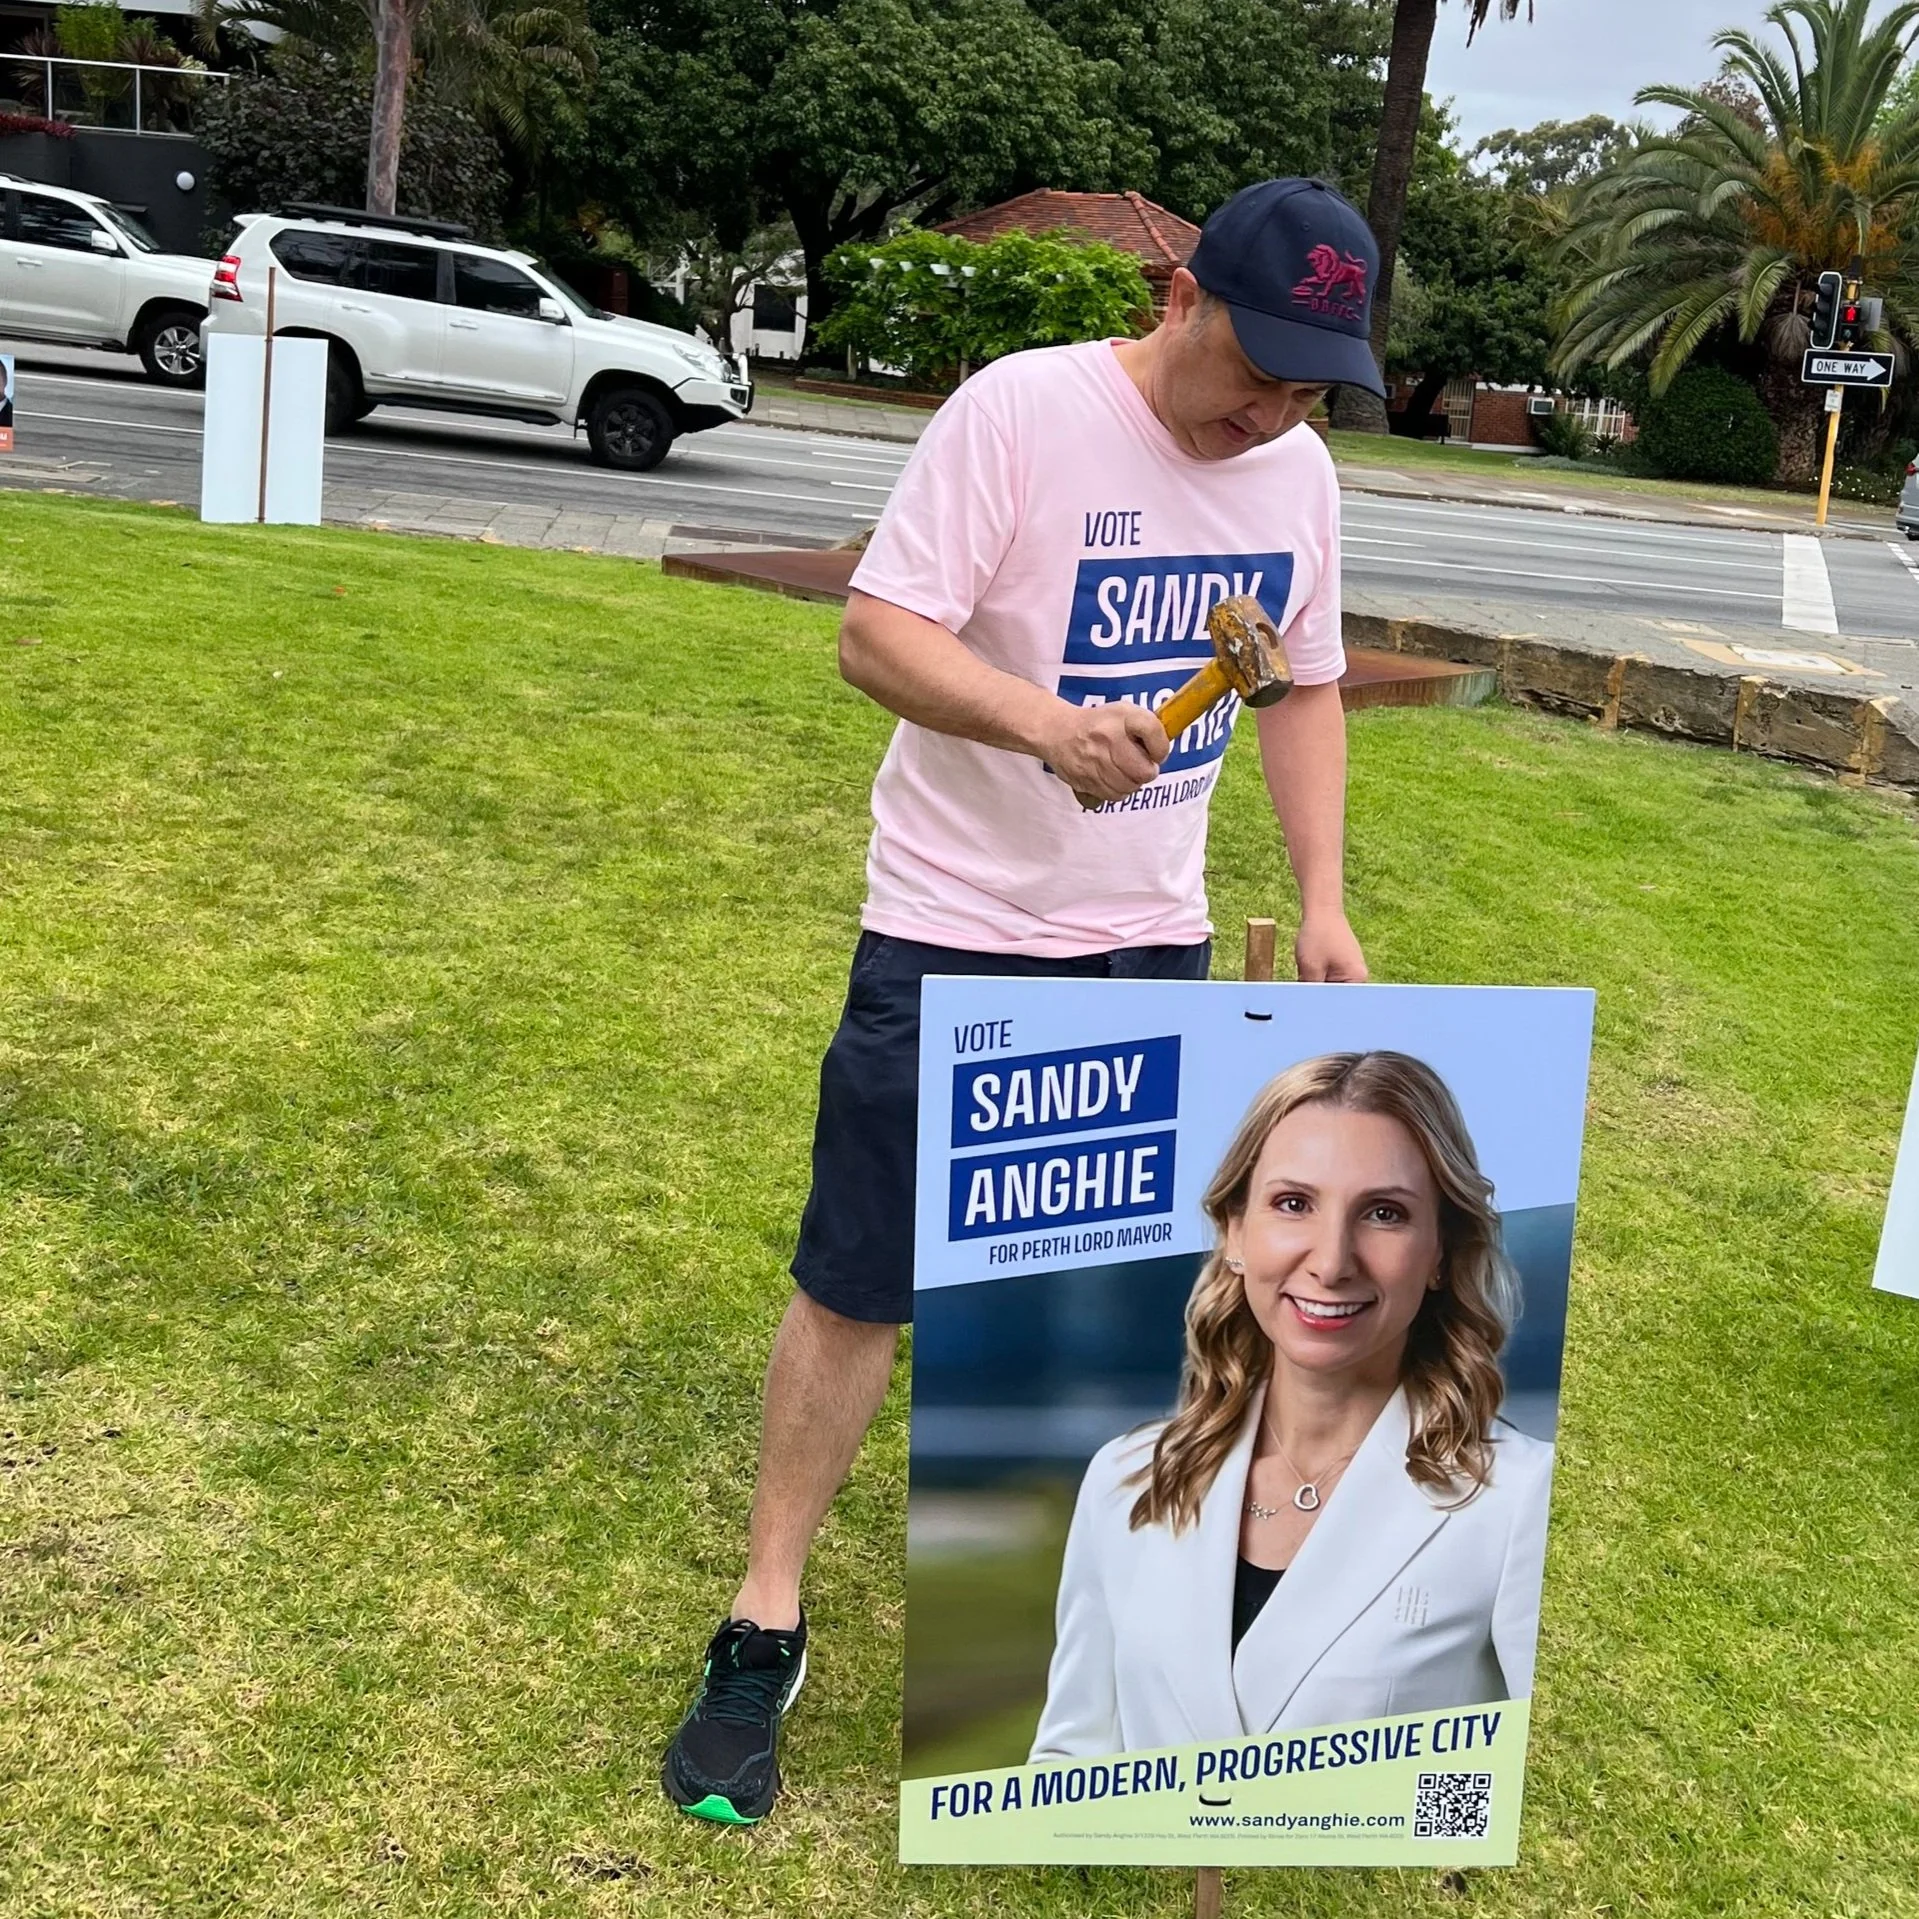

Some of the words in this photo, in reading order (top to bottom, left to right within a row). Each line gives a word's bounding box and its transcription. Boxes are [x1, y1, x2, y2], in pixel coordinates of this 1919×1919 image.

[1816, 360, 1837, 373] ONE
[1844, 362, 1866, 375] WAY
[1084, 511, 1142, 547] VOTE
[1120, 783, 1173, 813] PERTH
[954, 1019, 1013, 1053] VOTE
[969, 1053, 1144, 1132] SANDY
[964, 1145, 1159, 1227] ANGHIE
[989, 1243, 1018, 1265] FOR
[1022, 1235, 1071, 1261] PERTH
[1074, 1230, 1114, 1254] LORD
[1116, 1222, 1173, 1249] MAYOR
[931, 1780, 993, 1820] FOR
[1001, 1776, 1022, 1811] A
[1031, 1755, 1186, 1808] MODERN,
[1196, 1722, 1424, 1786] PROGRESSIVE
[1432, 1711, 1502, 1753] CITY
[1189, 1812, 1406, 1831] www.sandyanghie.com
